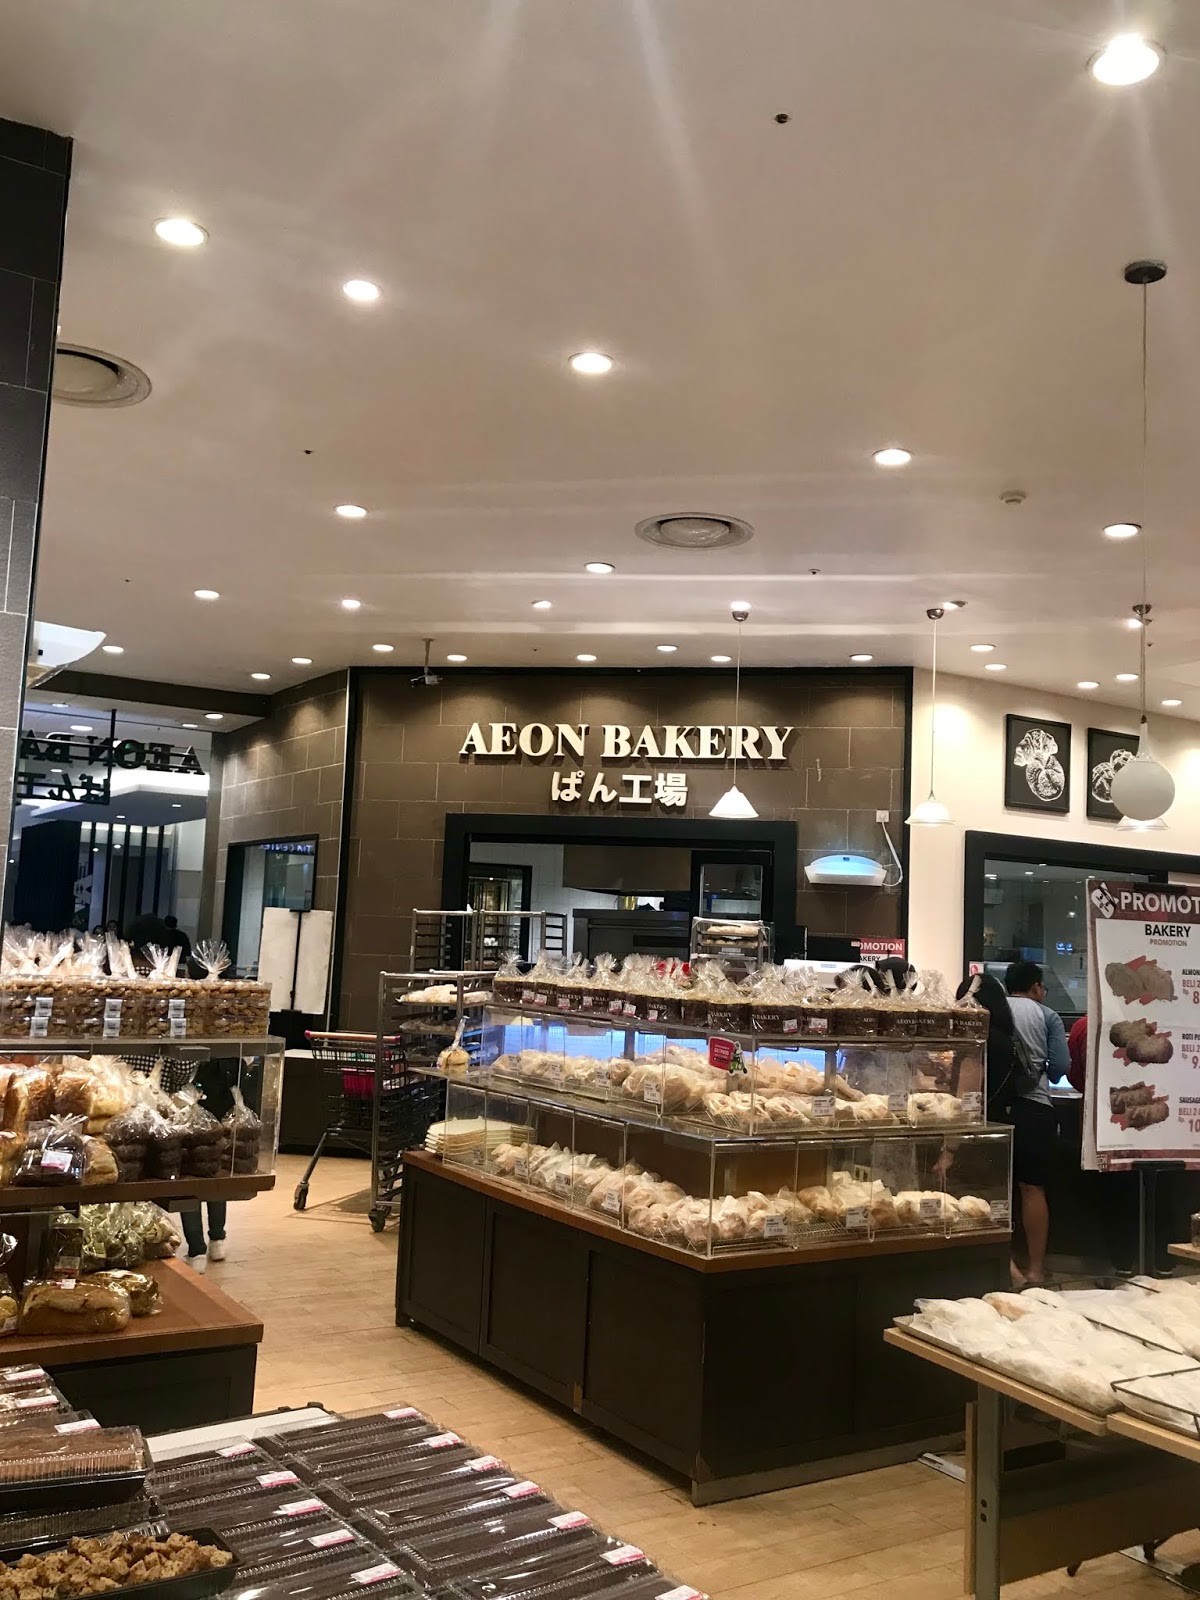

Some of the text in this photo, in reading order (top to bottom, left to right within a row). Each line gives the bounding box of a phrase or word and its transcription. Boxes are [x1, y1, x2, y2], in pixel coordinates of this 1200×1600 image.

[458, 722, 794, 760] AEON BAKERY
[551, 770, 688, 807] ぱん工場
[1120, 891, 1200, 914] PROMOT
[1144, 923, 1191, 938] BAKERY
[1149, 938, 1188, 947] PROMOTION
